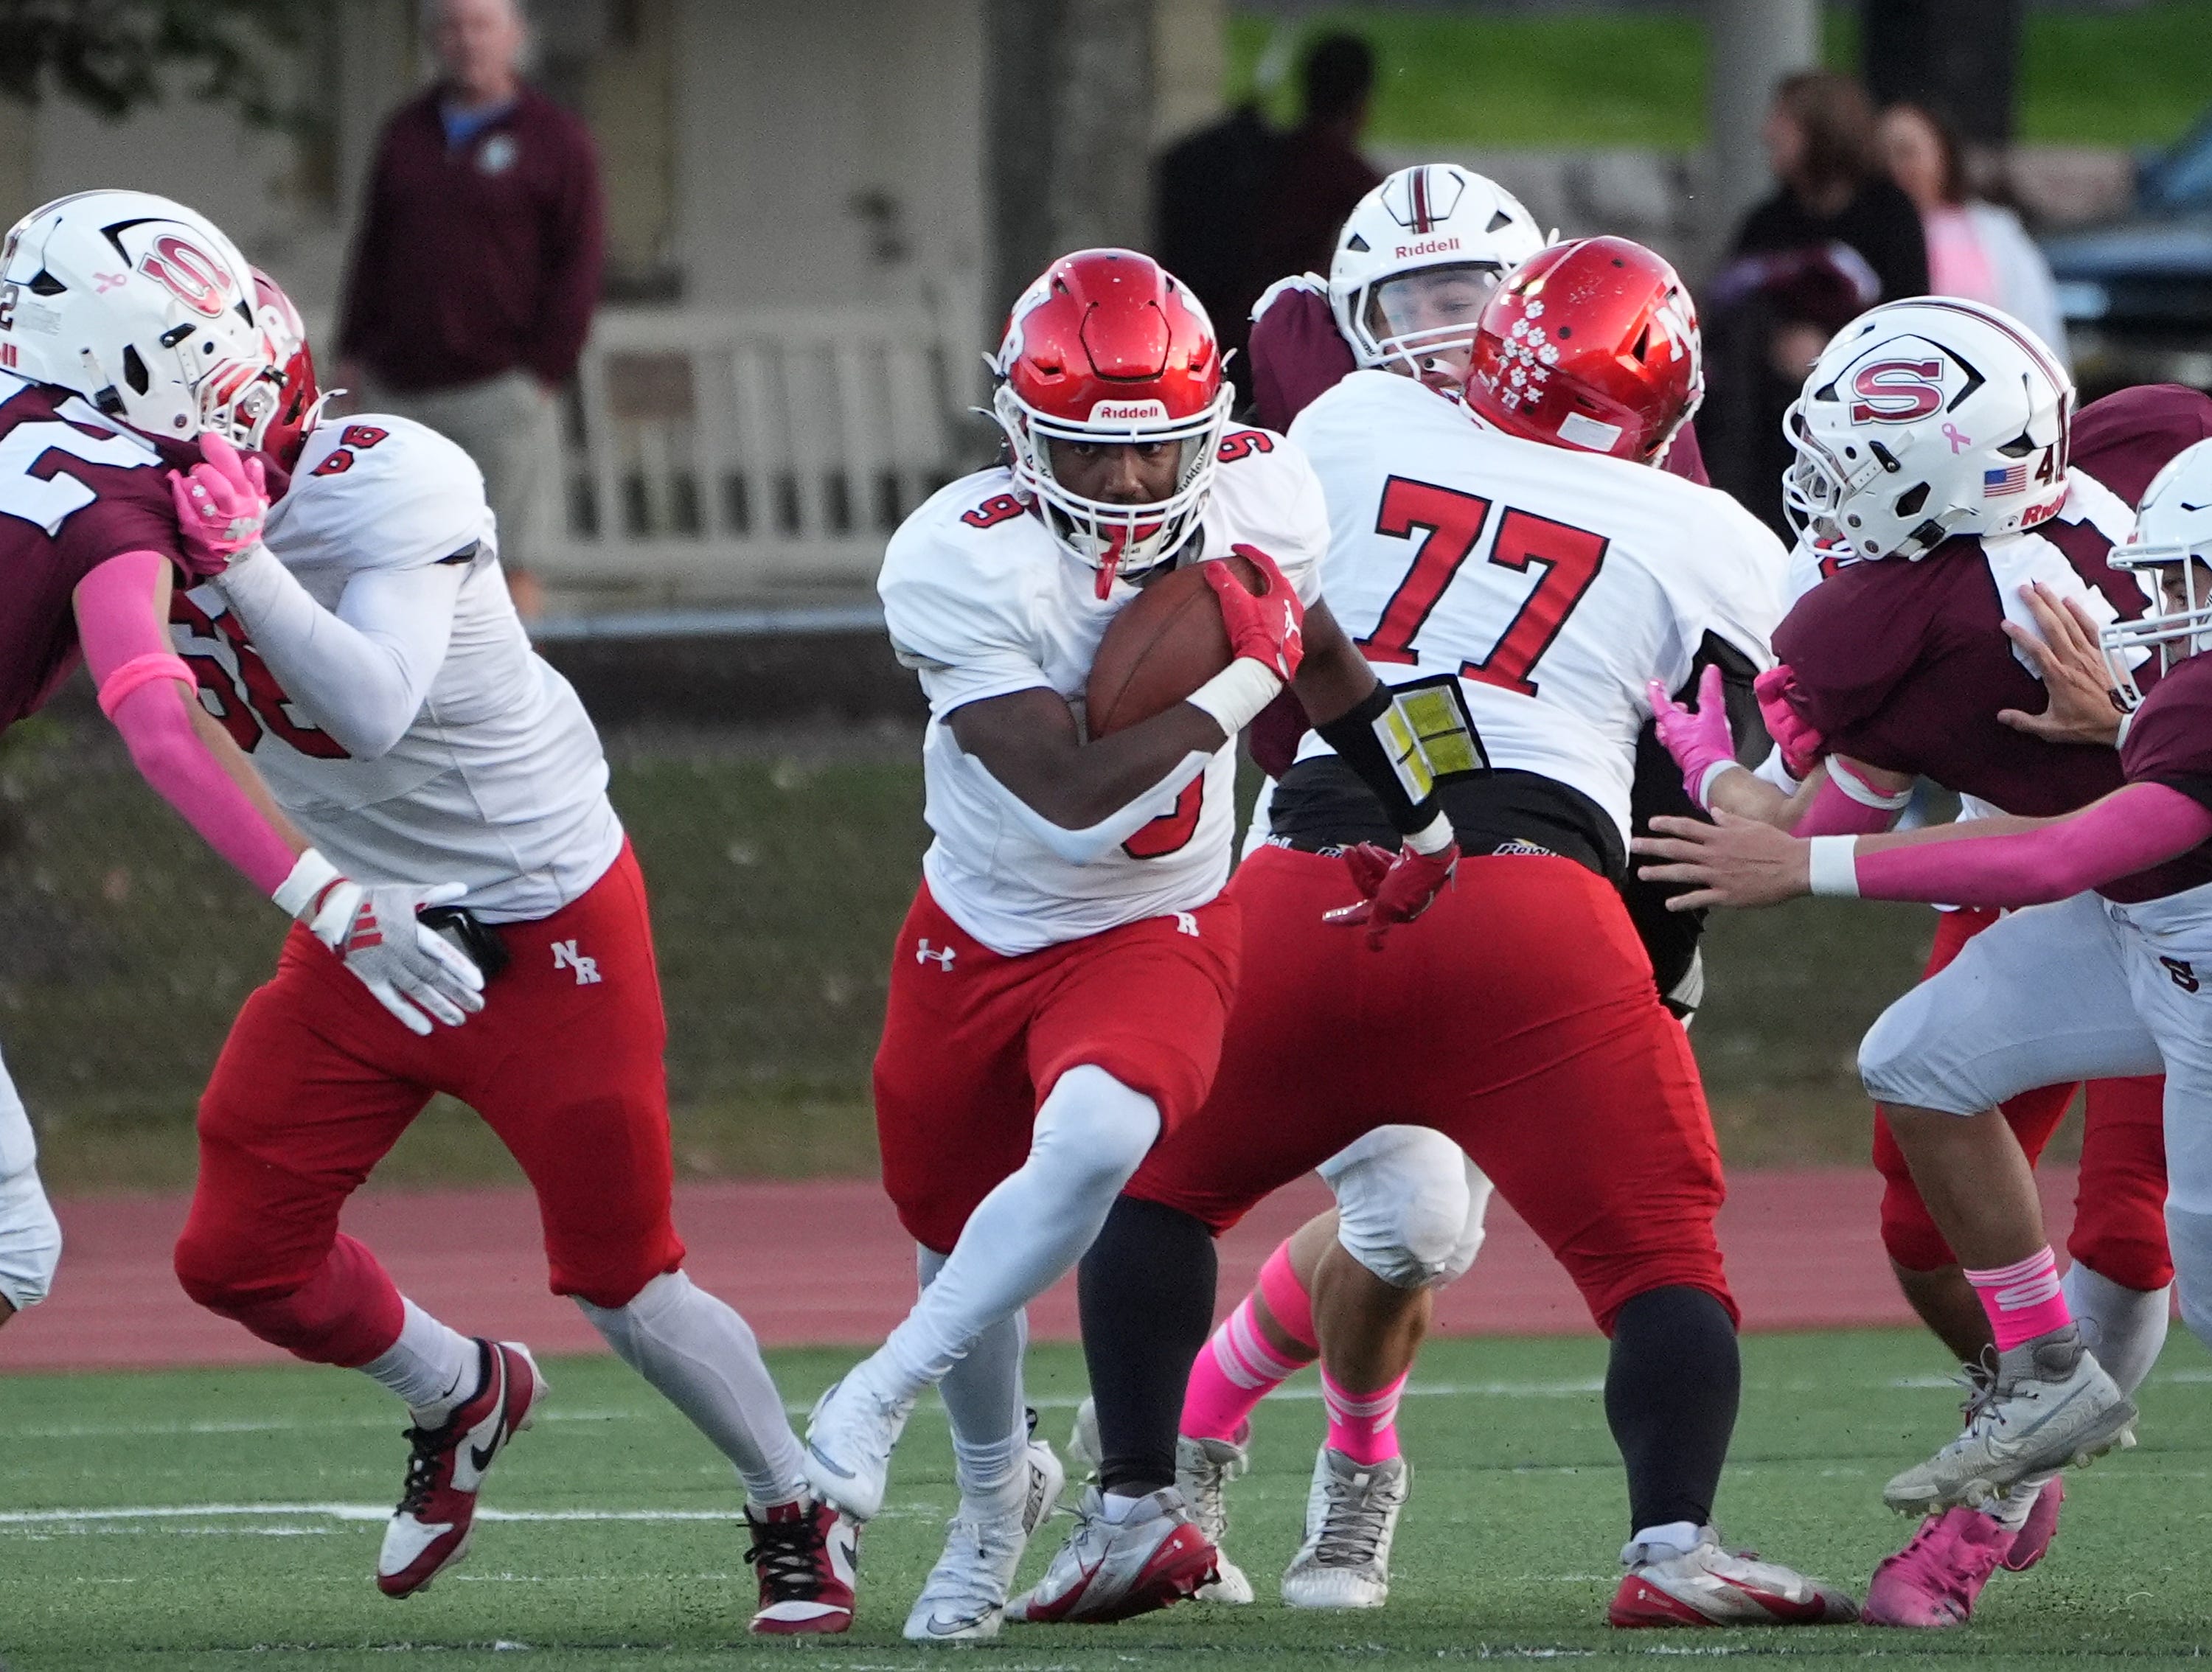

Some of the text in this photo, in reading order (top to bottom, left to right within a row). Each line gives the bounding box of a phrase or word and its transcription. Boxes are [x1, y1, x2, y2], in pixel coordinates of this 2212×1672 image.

[1395, 238, 1460, 259] Riddell
[1850, 358, 1944, 426] S
[1100, 407, 1158, 419] Riddell
[960, 493, 1025, 529] 9
[1353, 474, 1610, 697] 77
[550, 939, 602, 985] NR
